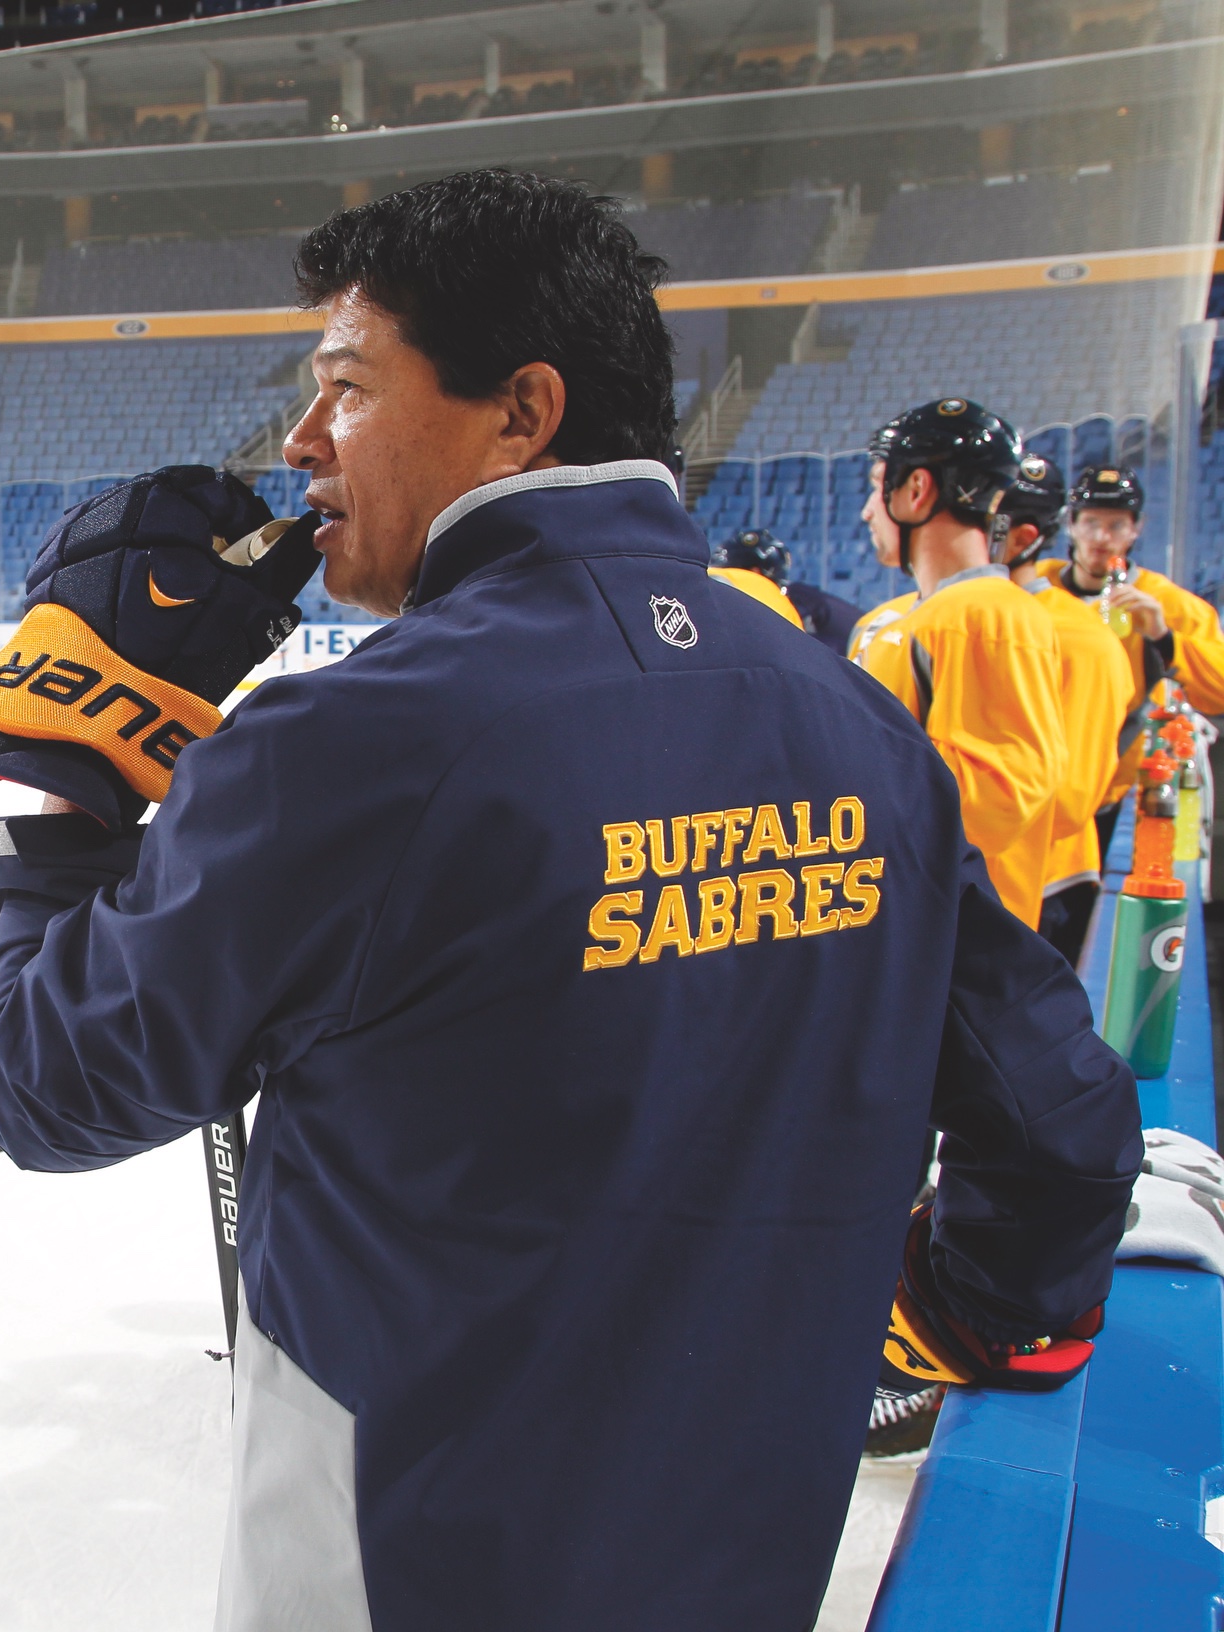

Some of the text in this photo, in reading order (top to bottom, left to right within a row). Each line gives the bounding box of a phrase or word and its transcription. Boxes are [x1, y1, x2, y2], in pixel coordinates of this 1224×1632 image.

[664, 610, 684, 637] NHL
[603, 795, 865, 885] BUFFALO
[582, 857, 885, 972] SABRES
